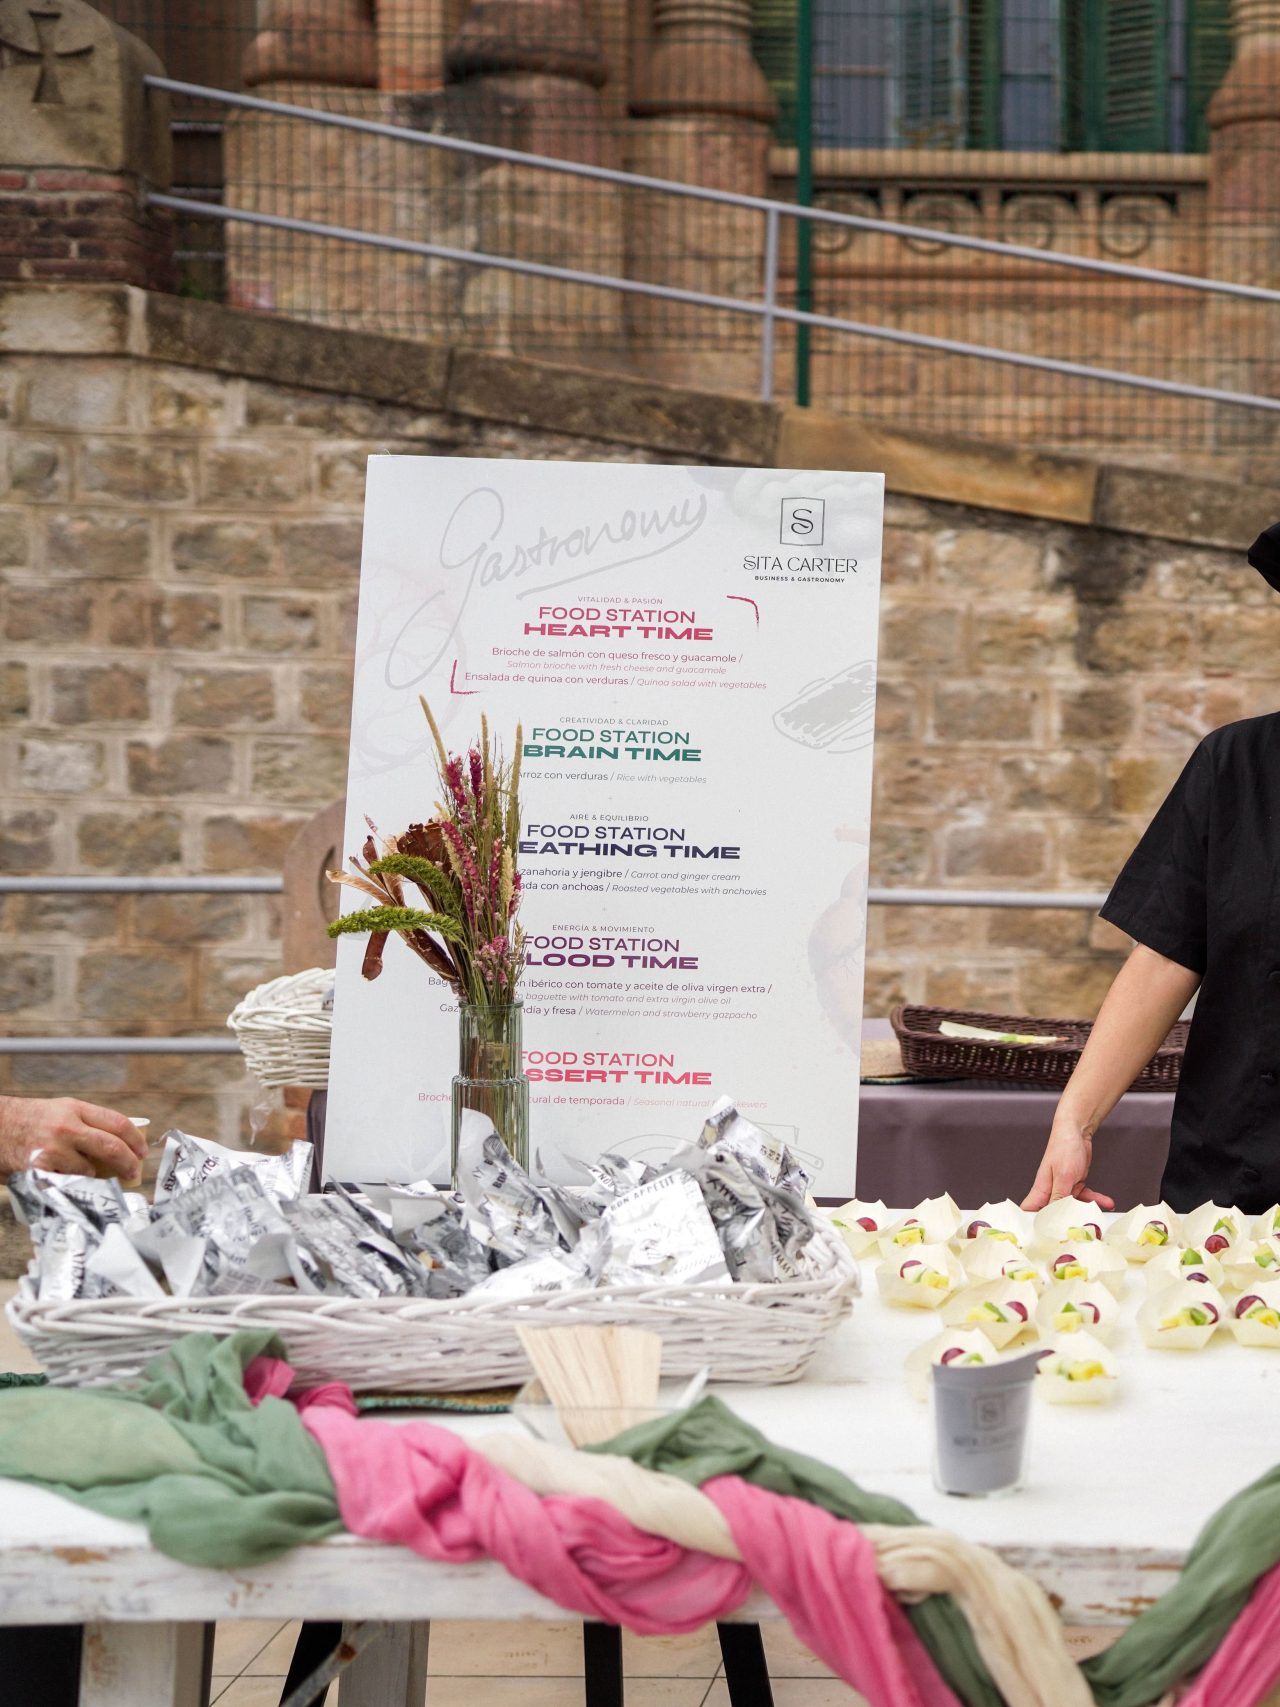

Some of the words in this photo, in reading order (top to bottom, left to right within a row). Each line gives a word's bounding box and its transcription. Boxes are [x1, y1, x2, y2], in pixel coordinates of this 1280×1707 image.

[791, 509, 814, 534] S
[743, 556, 783, 570] SITA
[787, 557, 858, 573] CARTER
[578, 596, 622, 604] VITALIDAD
[540, 607, 600, 620] FOOD
[606, 608, 695, 623] STATION
[524, 623, 631, 638] HEART
[637, 627, 713, 640] TIME
[492, 648, 530, 656] Brioche
[533, 648, 545, 657] de
[548, 649, 585, 658] salmón
[608, 652, 638, 662] queso
[642, 652, 670, 661] fresco
[672, 654, 679, 662] y
[681, 654, 736, 663] guacamole
[544, 662, 576, 670] brioche
[599, 663, 622, 672] fresh
[656, 665, 673, 673] and
[676, 666, 727, 674] guacamole
[466, 672, 510, 681] Ensalada
[512, 674, 525, 682] de
[528, 675, 563, 683] quinoa
[586, 676, 628, 685] verduras
[637, 678, 669, 687] Quinoa
[672, 678, 695, 687] salad
[698, 679, 717, 688] with
[720, 680, 767, 689] vegetables
[626, 718, 668, 726] CLARIDAD
[532, 728, 594, 742] FOOD
[600, 730, 690, 744] STATION
[524, 745, 618, 759] BRAIN
[625, 747, 702, 761] TIME
[566, 772, 608, 781] verduras
[617, 773, 635, 782] Rice
[637, 774, 656, 782] with
[659, 775, 706, 784] vegetables
[527, 824, 590, 839] FOOD
[595, 826, 685, 841] STATION
[519, 841, 657, 857] EATHING
[664, 845, 740, 859] TIME
[521, 867, 570, 877] zanahoria
[573, 870, 578, 879] y
[580, 868, 622, 878] jengibre
[631, 870, 658, 879] Carrot
[660, 871, 678, 879] and
[680, 872, 710, 881] ginger
[562, 882, 604, 892] anchoas
[612, 884, 649, 893] Roasted
[650, 885, 698, 894] vegetables
[701, 886, 720, 894] with
[722, 886, 767, 896] anchovies
[552, 924, 590, 932] ENERGÍA
[523, 936, 584, 949] FOOD
[589, 938, 679, 952] STATION
[621, 956, 698, 969] TIME
[528, 979, 562, 988] ibérico
[586, 982, 623, 990] tomate
[634, 982, 663, 990] aceite
[666, 983, 679, 991] de
[682, 983, 704, 991] oliva
[707, 984, 738, 993] virgen
[526, 993, 566, 1002] baguette
[626, 995, 644, 1003] and
[671, 996, 696, 1005] virgin
[523, 1005, 541, 1014] ndía
[543, 1008, 549, 1016] y
[553, 1006, 576, 1014] fresa
[585, 1007, 640, 1016] Watermelon
[663, 1010, 710, 1019] strawberry
[713, 1011, 757, 1020] gazpacho
[583, 1052, 674, 1067] STATION
[525, 1068, 628, 1083] SSERT
[634, 1071, 712, 1085] TIME
[419, 1092, 452, 1102] Broche
[554, 1096, 566, 1104] de
[569, 1097, 625, 1106] temporada
[634, 1097, 673, 1107] Seasonal
[676, 1098, 710, 1108] natural
